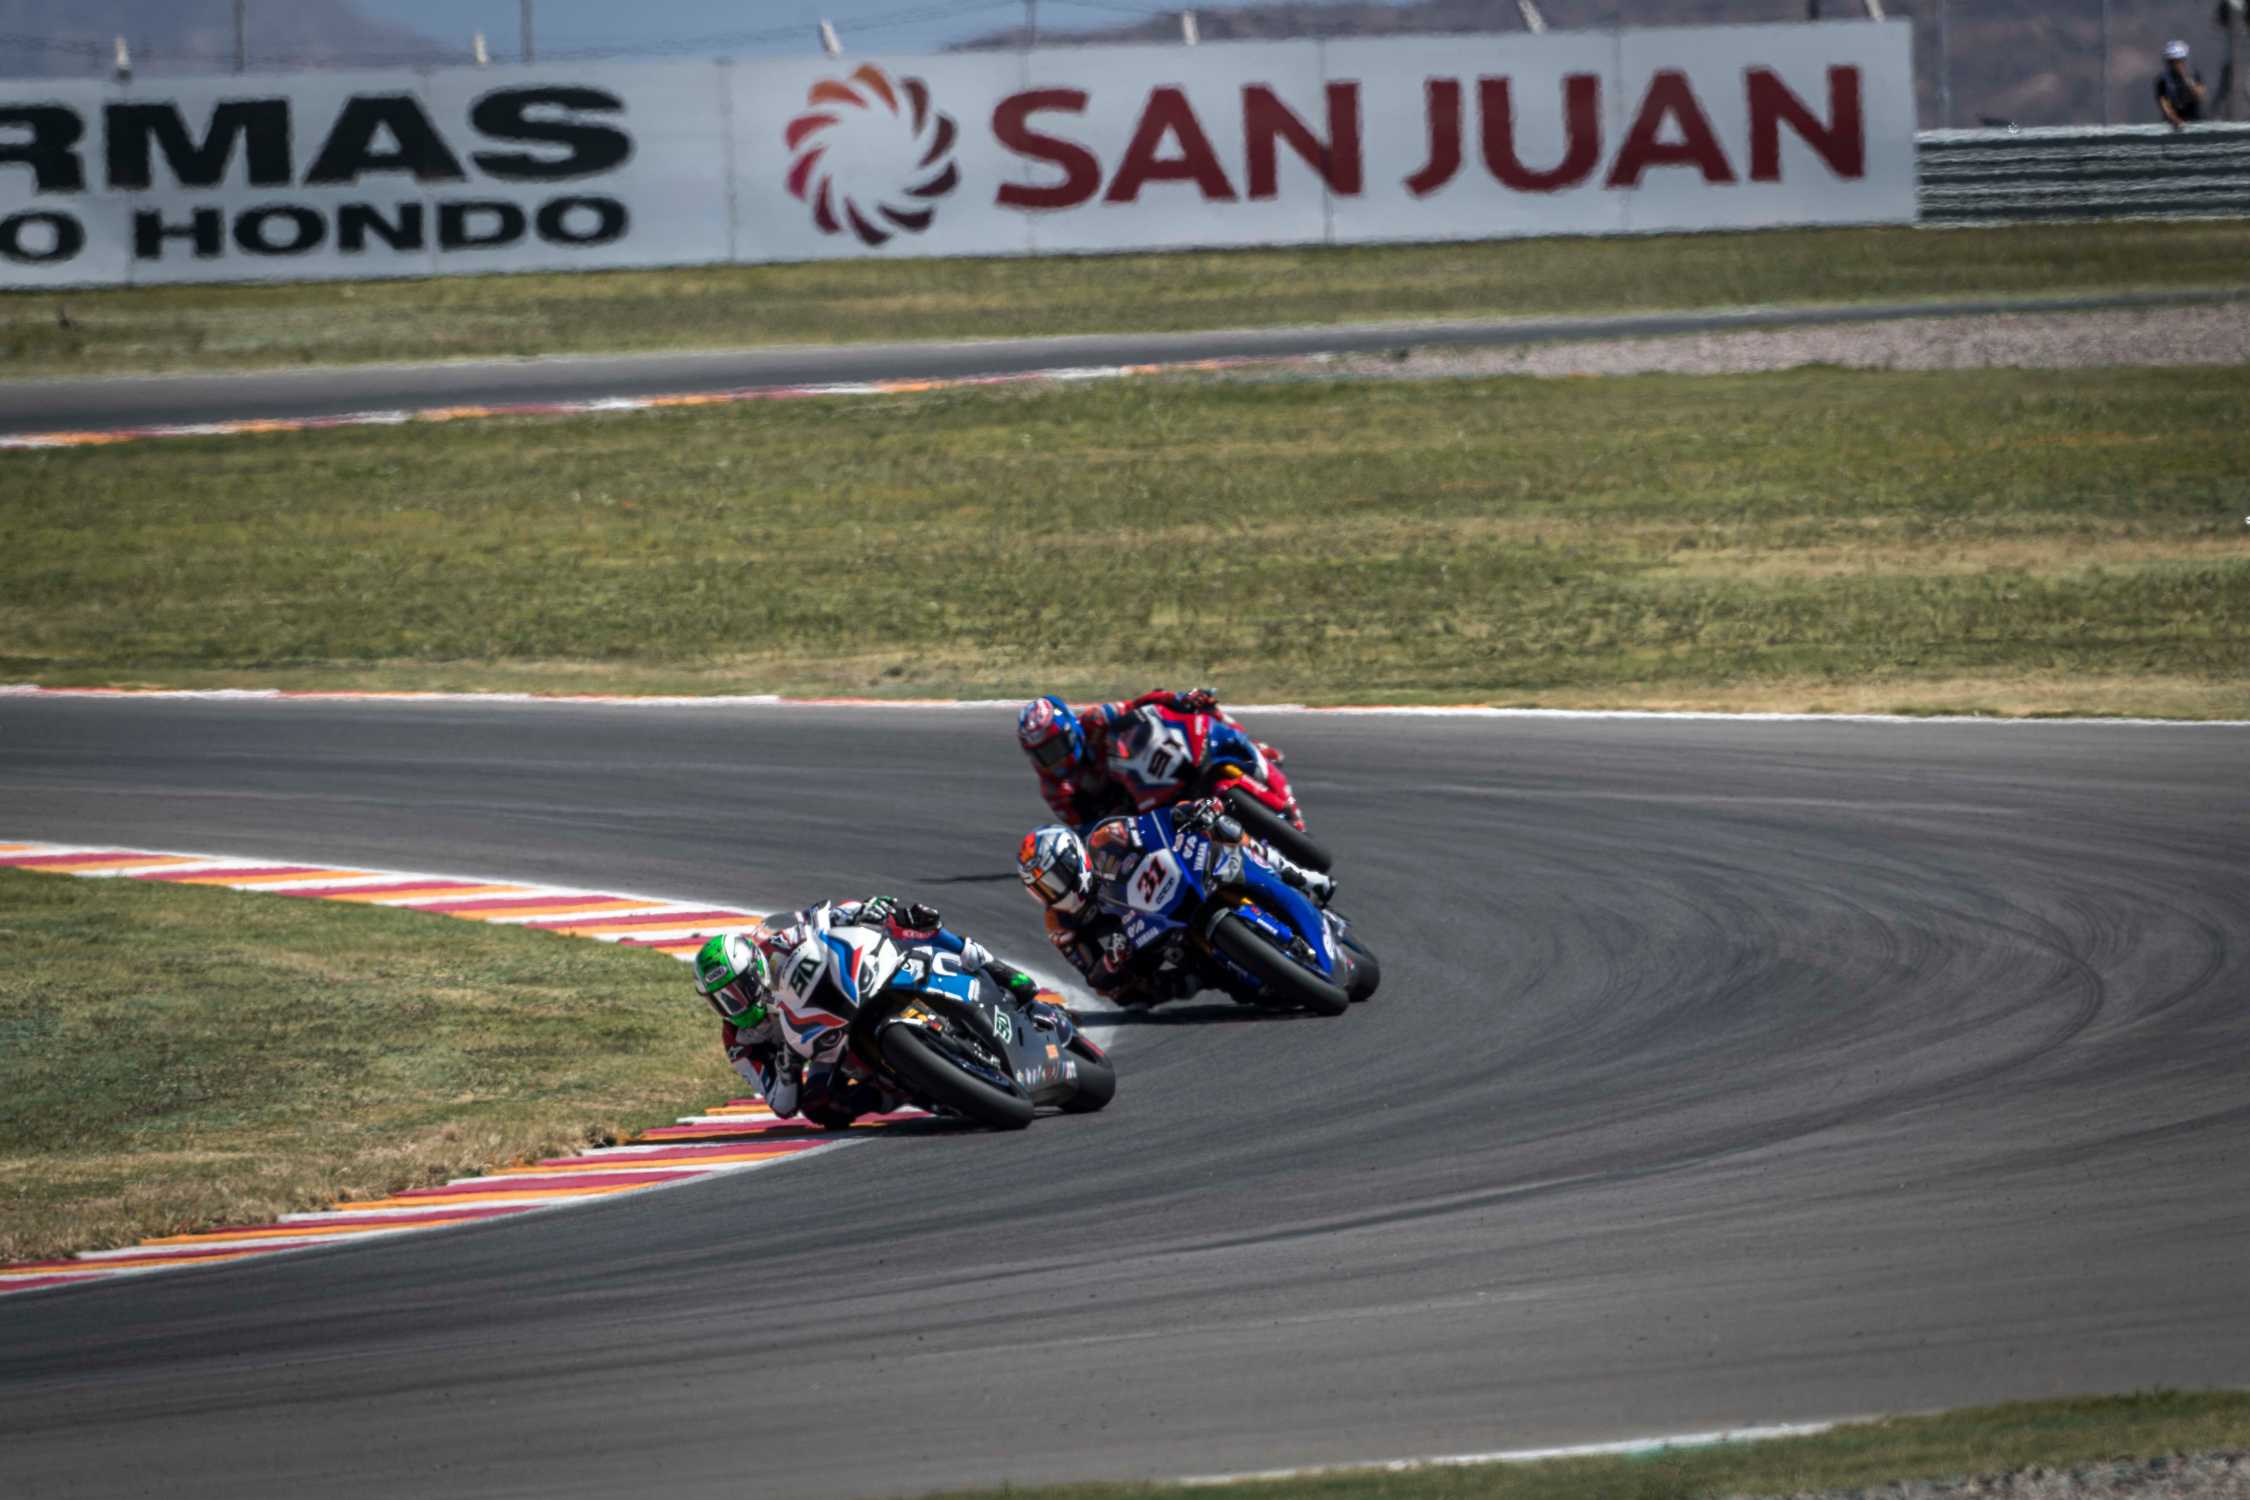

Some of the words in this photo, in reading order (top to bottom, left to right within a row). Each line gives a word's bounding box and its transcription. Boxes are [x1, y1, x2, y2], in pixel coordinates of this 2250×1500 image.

[0, 84, 634, 193] RMAS
[992, 82, 1363, 211] SAN
[1404, 64, 1867, 198] JUAN
[133, 196, 629, 260] HONDO
[1137, 856, 1169, 905] 31
[790, 958, 821, 999] 50
